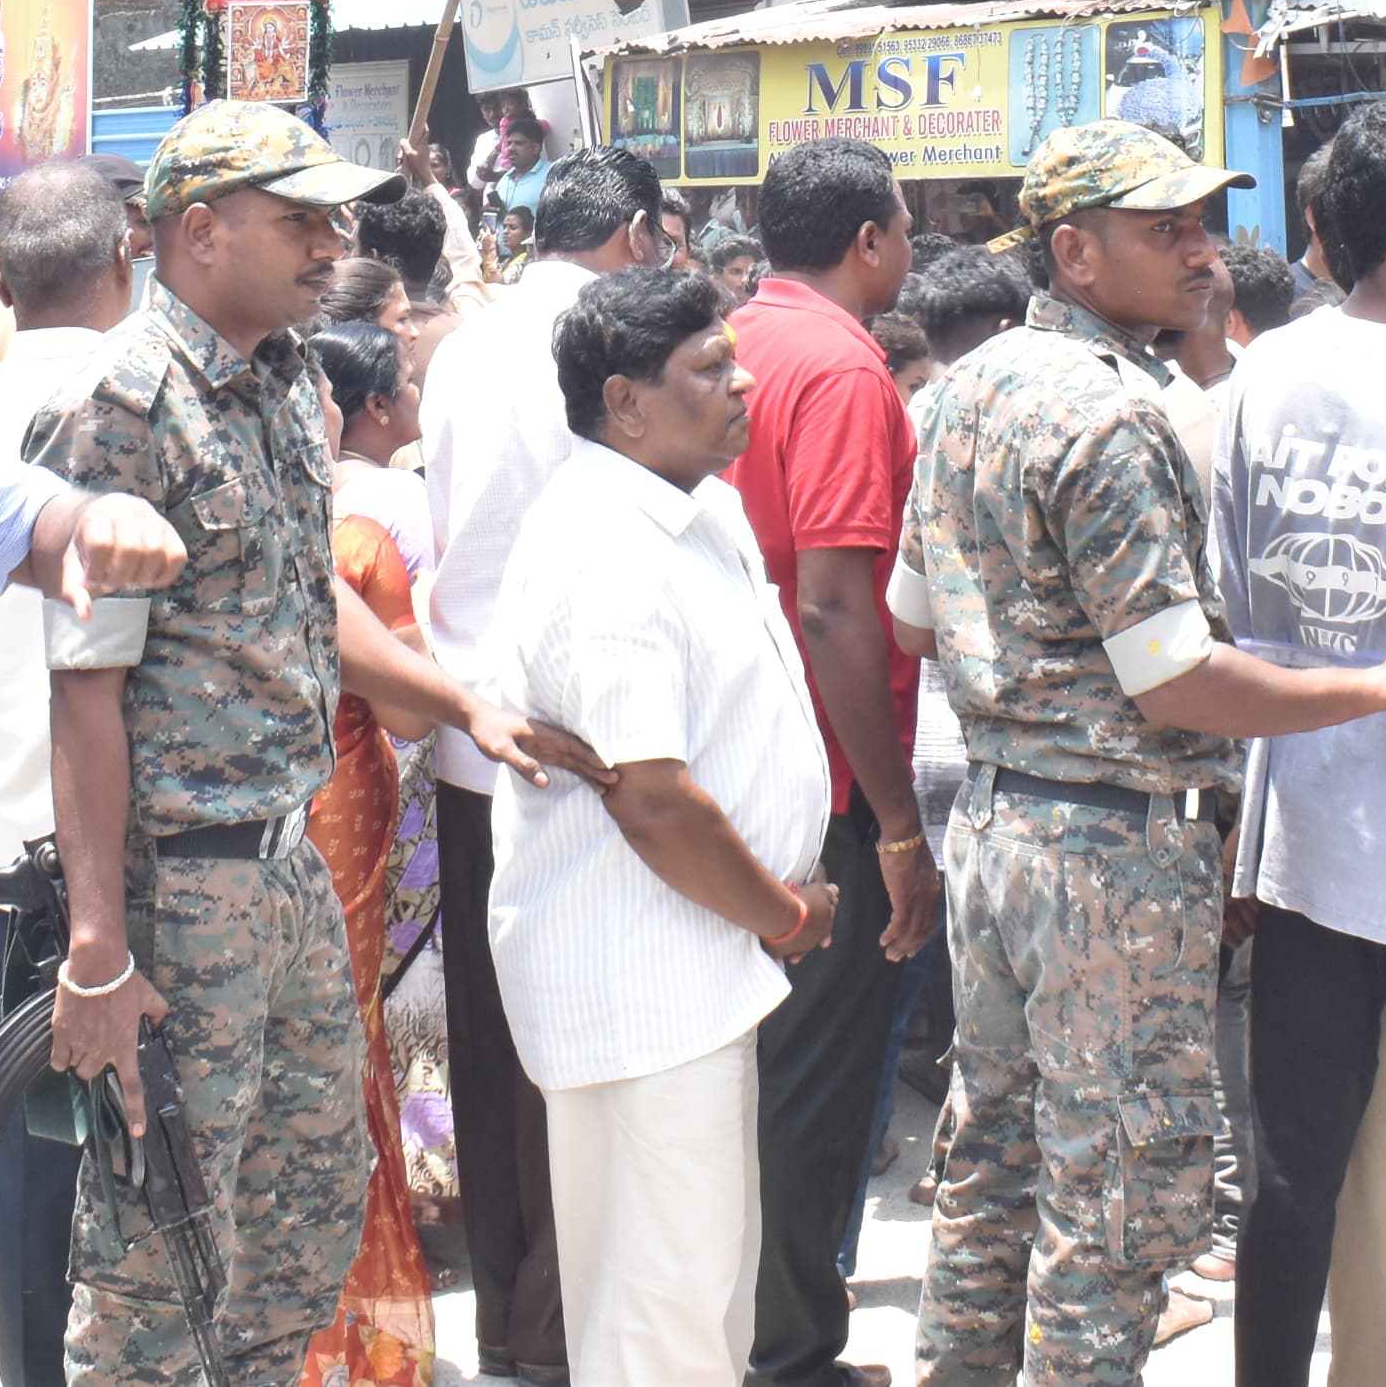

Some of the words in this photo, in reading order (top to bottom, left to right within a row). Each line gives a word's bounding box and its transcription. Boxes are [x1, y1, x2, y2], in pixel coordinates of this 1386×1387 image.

[803, 51, 967, 115] MSF
[768, 121, 821, 146] FLOWER
[824, 114, 900, 143] MERCHANT
[902, 113, 914, 138] &
[918, 109, 1003, 138] DECORATER
[922, 142, 1003, 165] Merchant
